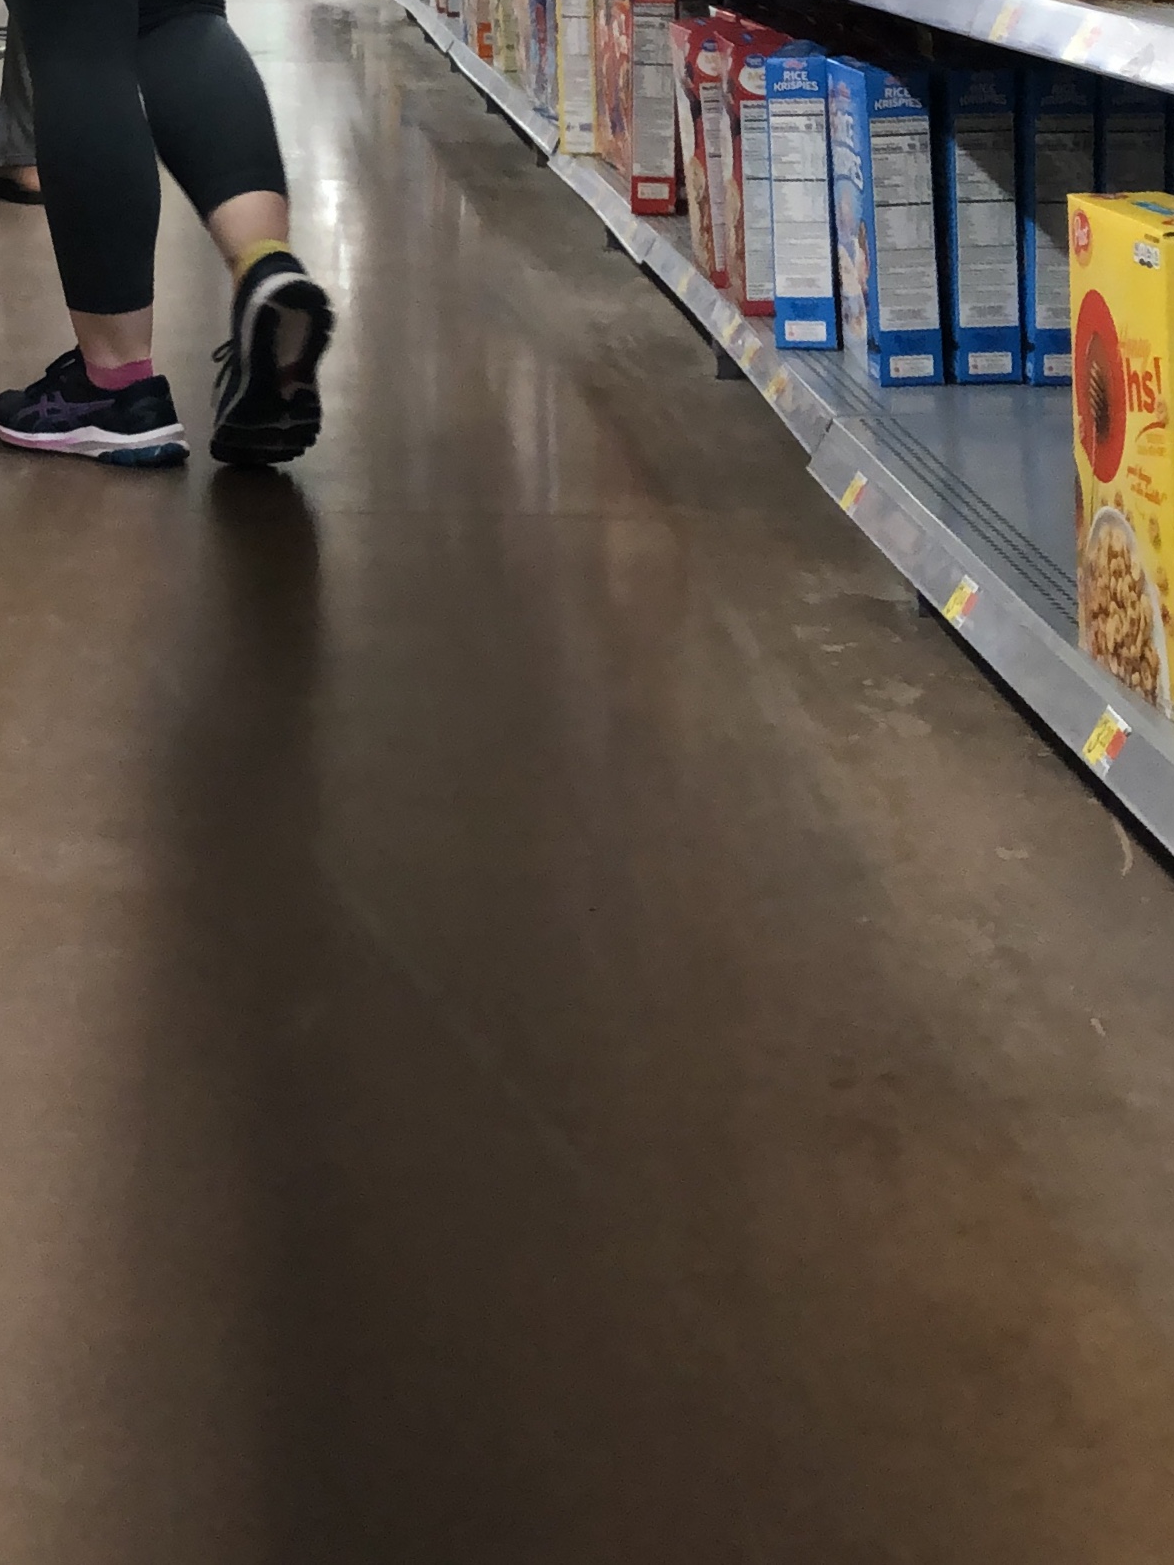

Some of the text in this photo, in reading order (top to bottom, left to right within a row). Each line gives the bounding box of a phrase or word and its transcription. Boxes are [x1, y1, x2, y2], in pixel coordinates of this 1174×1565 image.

[783, 70, 809, 82] RICE
[774, 80, 819, 93] KRISPIES
[884, 87, 911, 99] RICE
[874, 98, 923, 111] KRISPIES
